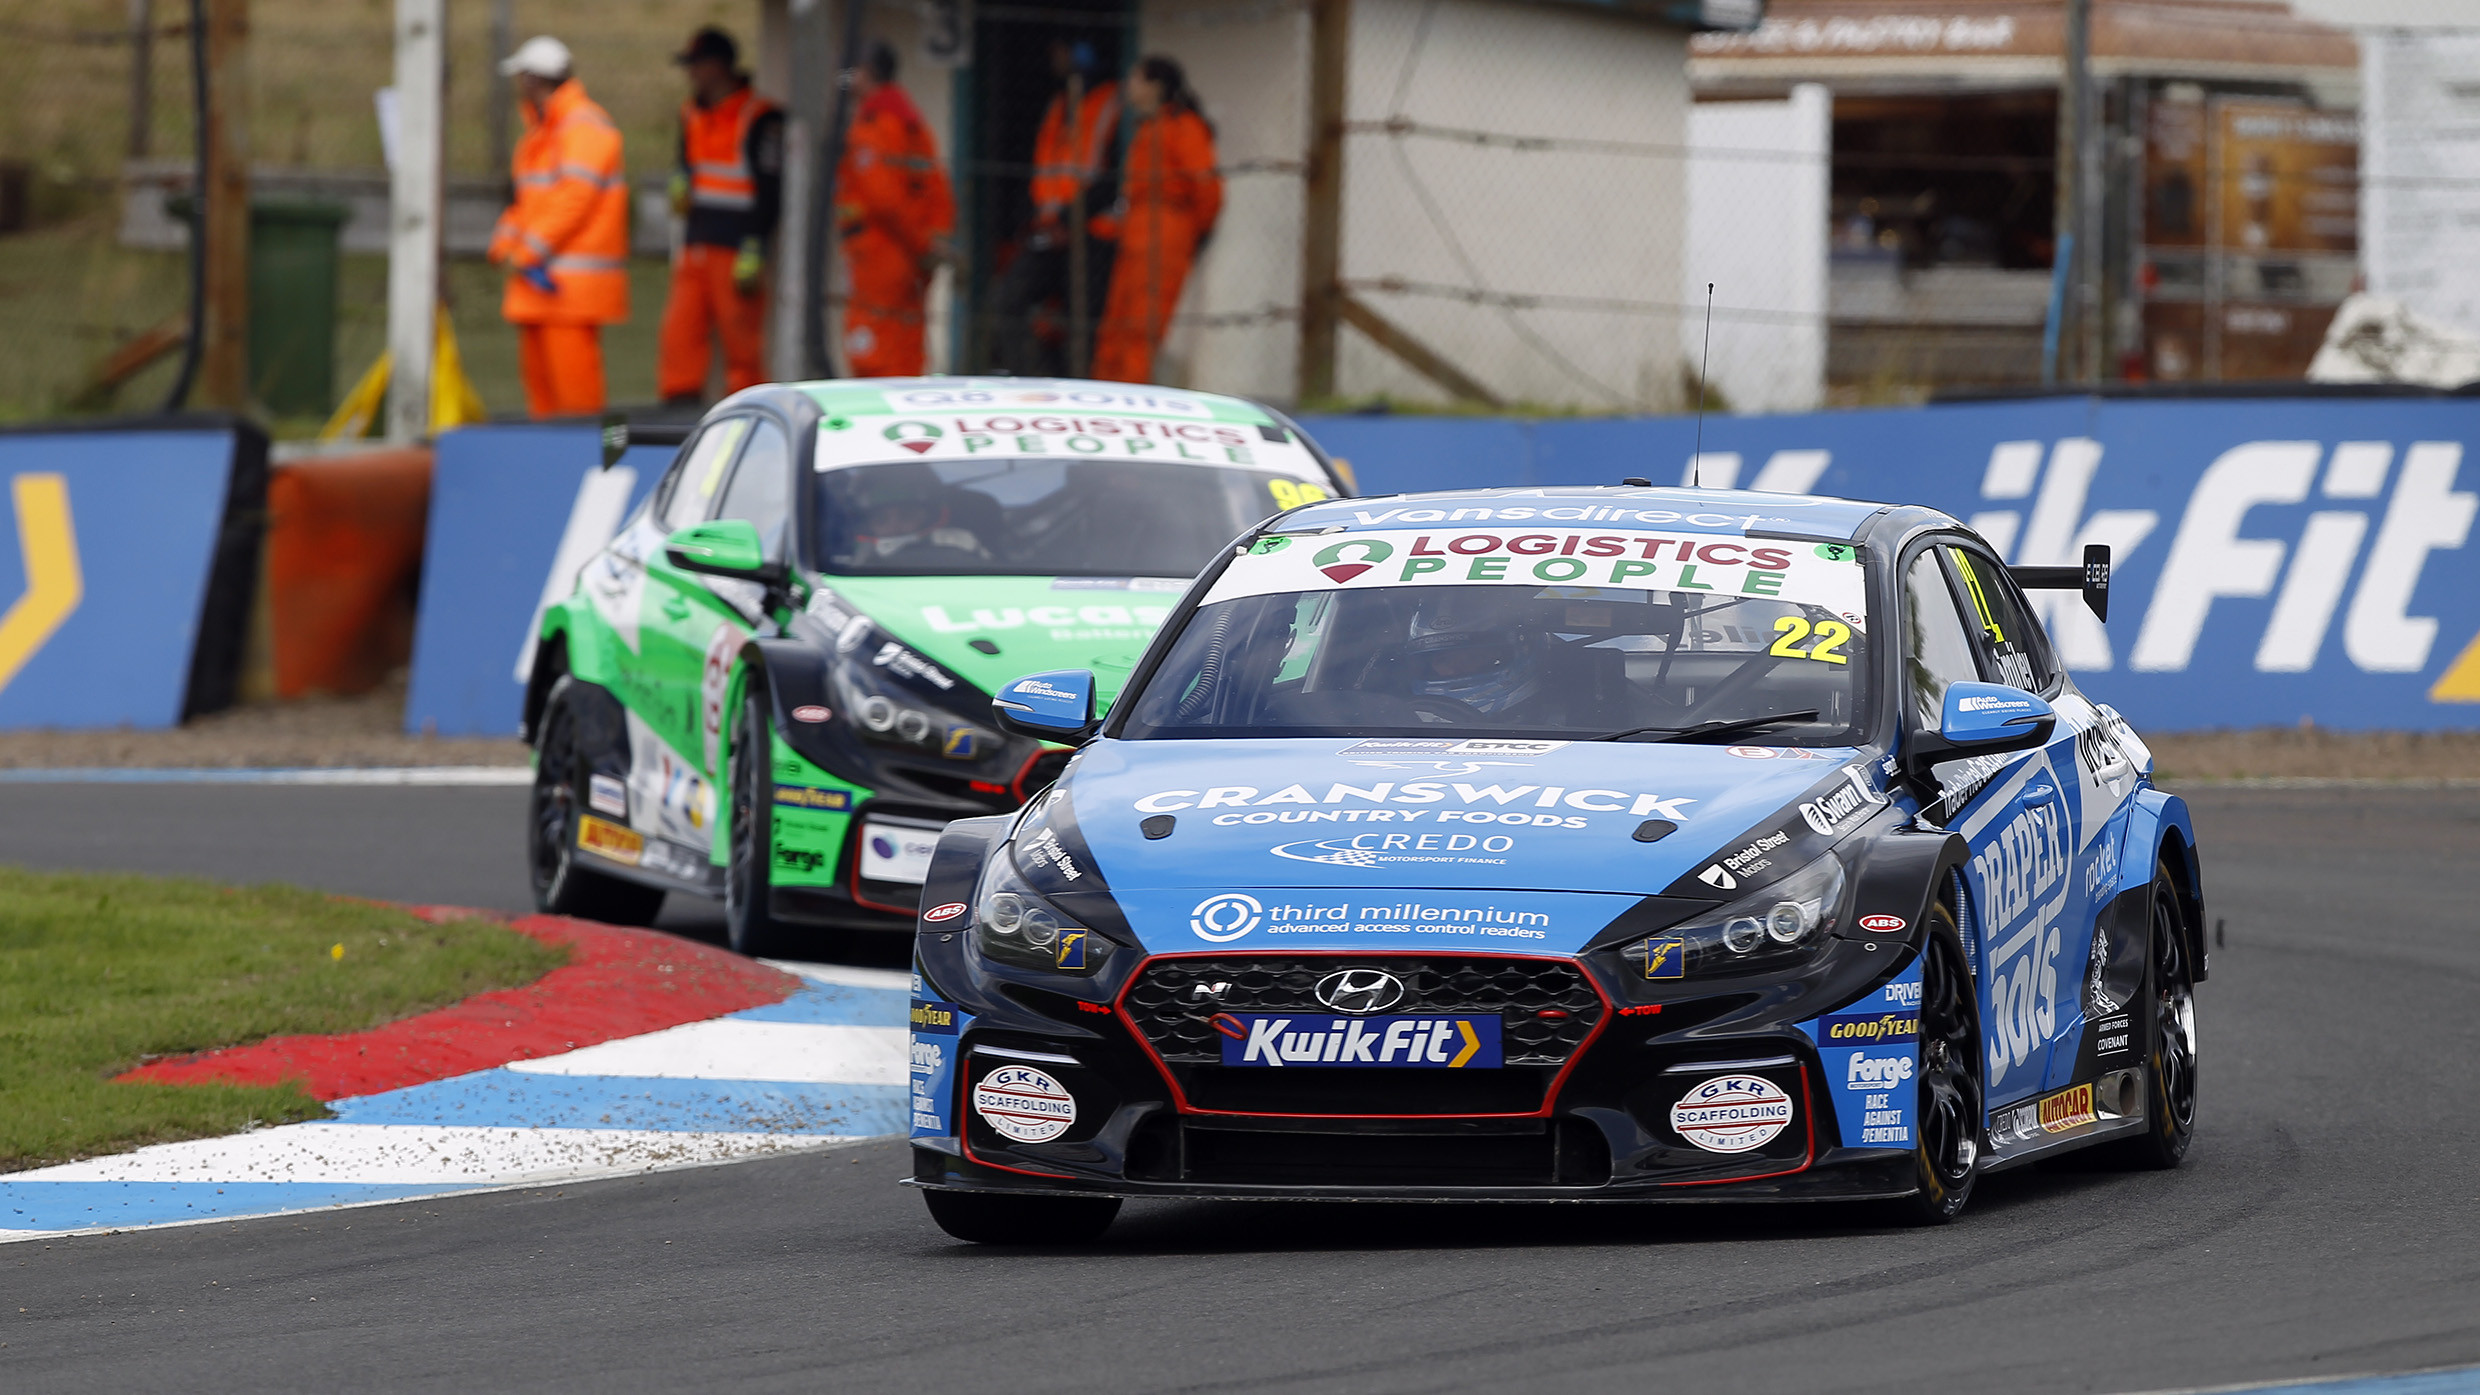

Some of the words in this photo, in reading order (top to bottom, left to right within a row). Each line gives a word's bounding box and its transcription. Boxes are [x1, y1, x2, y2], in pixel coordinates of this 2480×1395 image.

[956, 417, 1246, 446] LOGISTICS
[964, 434, 1257, 465] PEOPLE
[1410, 534, 1793, 571] LOGISTICS
[1399, 556, 1787, 597] PEOPLE
[921, 605, 1171, 633] Lucas
[1769, 616, 1851, 665] 22
[1977, 700, 2031, 710] Windscreens
[1465, 742, 1551, 750] BTCC
[1132, 781, 1699, 822] CRANSWICK
[1816, 783, 1864, 825] Swann
[1211, 809, 1430, 826] COUNTRY
[1435, 810, 1588, 829] FOODS
[1350, 833, 1514, 853] CREDO
[1723, 843, 1763, 871] Bristol
[1755, 830, 1790, 851] Street
[1377, 856, 1454, 864] MOTORSPORT
[1457, 857, 1507, 866] FINANCE
[1736, 857, 1773, 879] Motors
[1973, 801, 2064, 941] DRAPER
[2085, 831, 2117, 898] rocket
[930, 904, 962, 920] ABS
[1268, 903, 1349, 921] third
[1359, 903, 1550, 927] millennium
[1267, 922, 1350, 935] advanced
[1353, 923, 1411, 934] access
[1415, 923, 1475, 936] control
[1479, 926, 1546, 940] readers
[1865, 917, 1901, 929] ABS
[1634, 1004, 1663, 1016] TOW
[1242, 1018, 1455, 1067] KwikFit
[2097, 1034, 2129, 1052] COVENANT
[997, 1070, 1051, 1091] GKR
[1700, 1079, 1765, 1098] GKR
[978, 1094, 1072, 1114] SCAFFOLDING
[1865, 1093, 1890, 1110] RACE
[2043, 1087, 2091, 1130] AUTOCAR
[1676, 1104, 1788, 1123] SCAFFOLDING
[1863, 1109, 1903, 1127] AGAINST
[997, 1118, 1056, 1136] LIMITED
[1699, 1128, 1768, 1146] LIMITED
[1861, 1126, 1909, 1143] DEMENTIA
